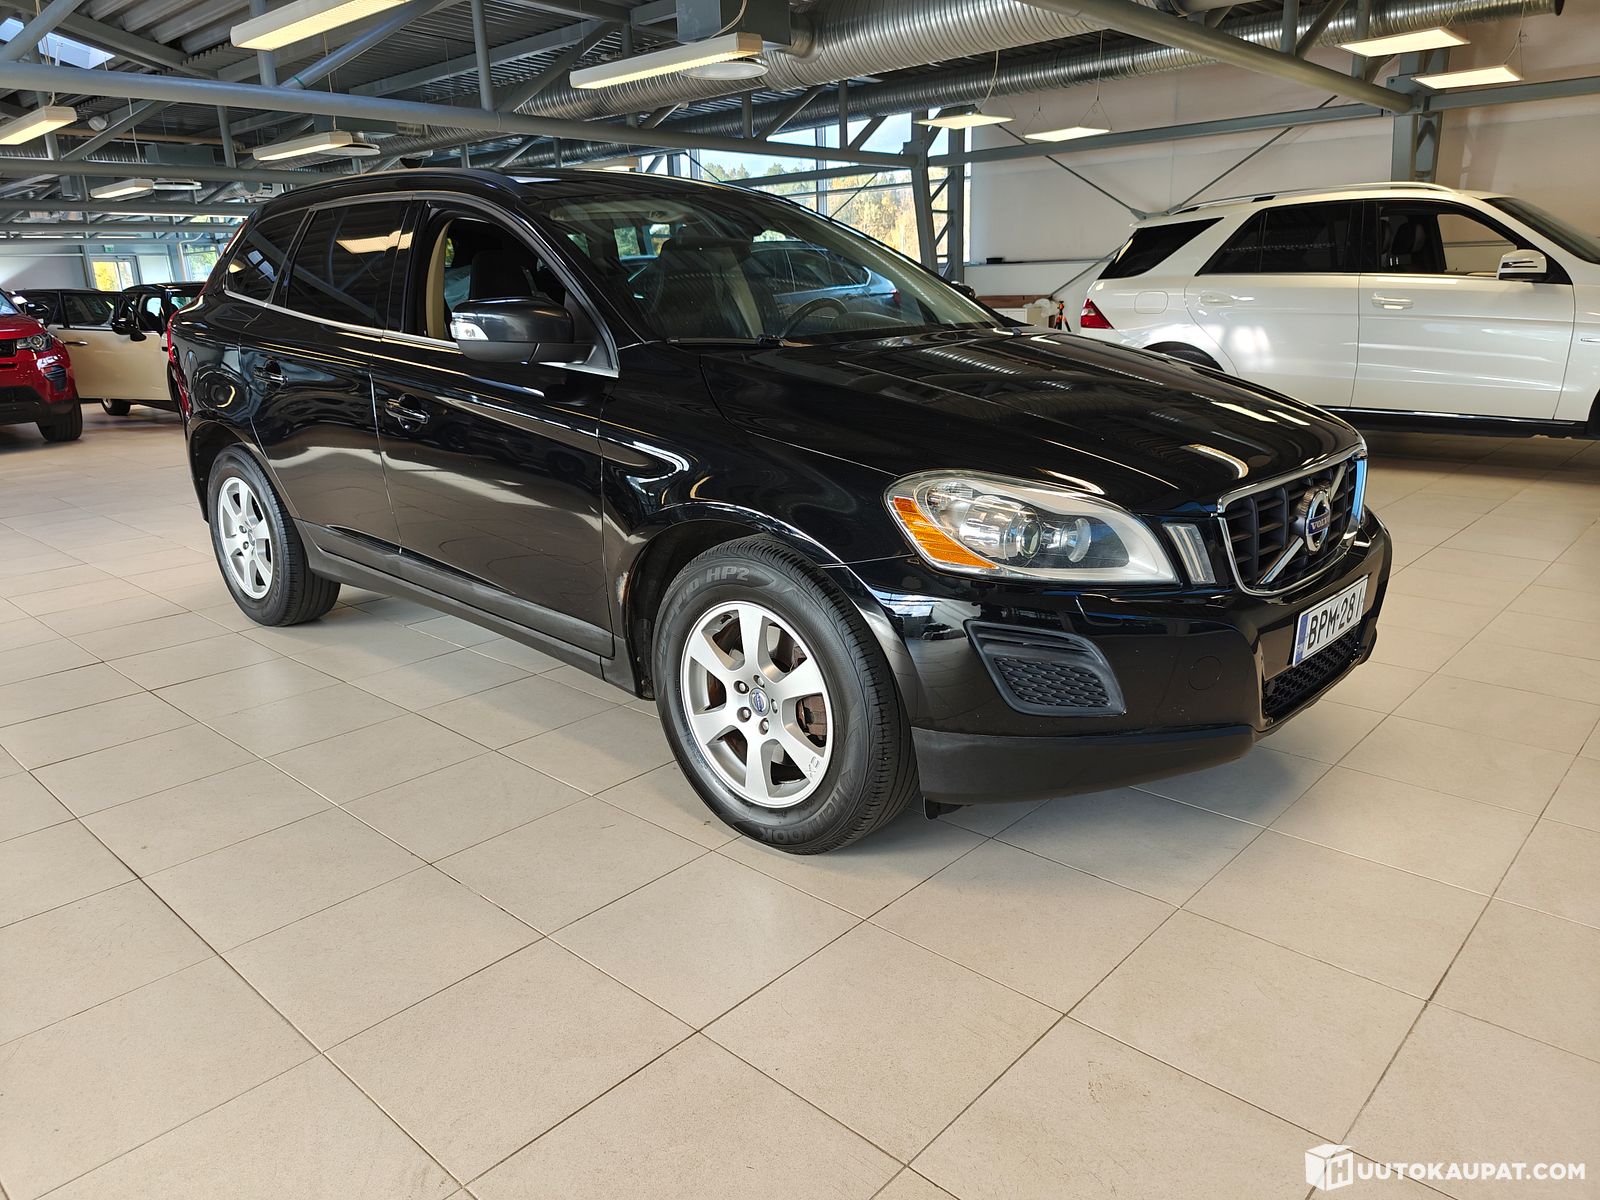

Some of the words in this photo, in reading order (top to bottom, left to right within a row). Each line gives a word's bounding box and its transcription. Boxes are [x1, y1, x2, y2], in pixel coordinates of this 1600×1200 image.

[1310, 516, 1330, 530] VOLV
[705, 566, 750, 583] HP2
[1307, 587, 1362, 651] BPM-281
